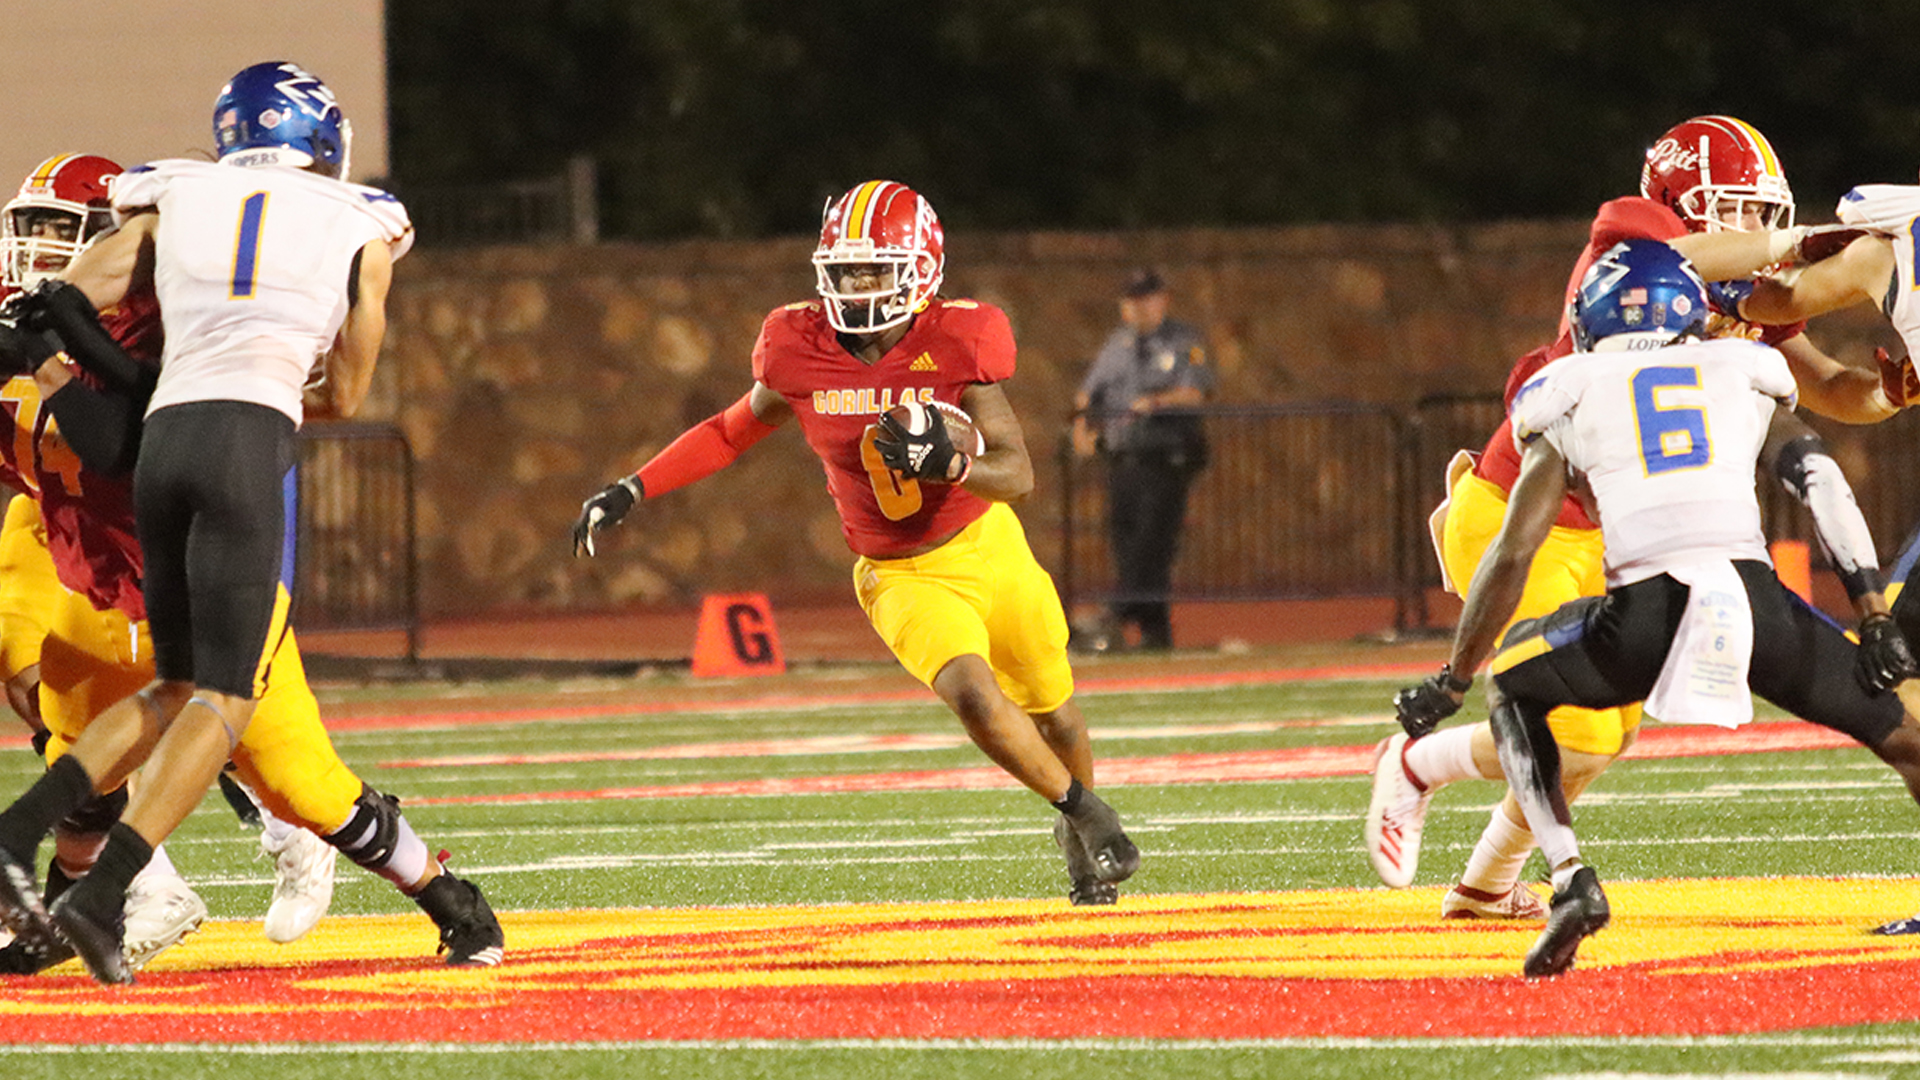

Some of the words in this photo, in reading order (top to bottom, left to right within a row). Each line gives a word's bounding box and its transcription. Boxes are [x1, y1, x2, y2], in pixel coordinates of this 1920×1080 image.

[1650, 138, 1701, 171] Pitt
[227, 189, 271, 301] 1
[1628, 364, 1715, 479] 6
[913, 443, 934, 472] adidas
[726, 604, 775, 666] G
[1715, 635, 1725, 652] 6
